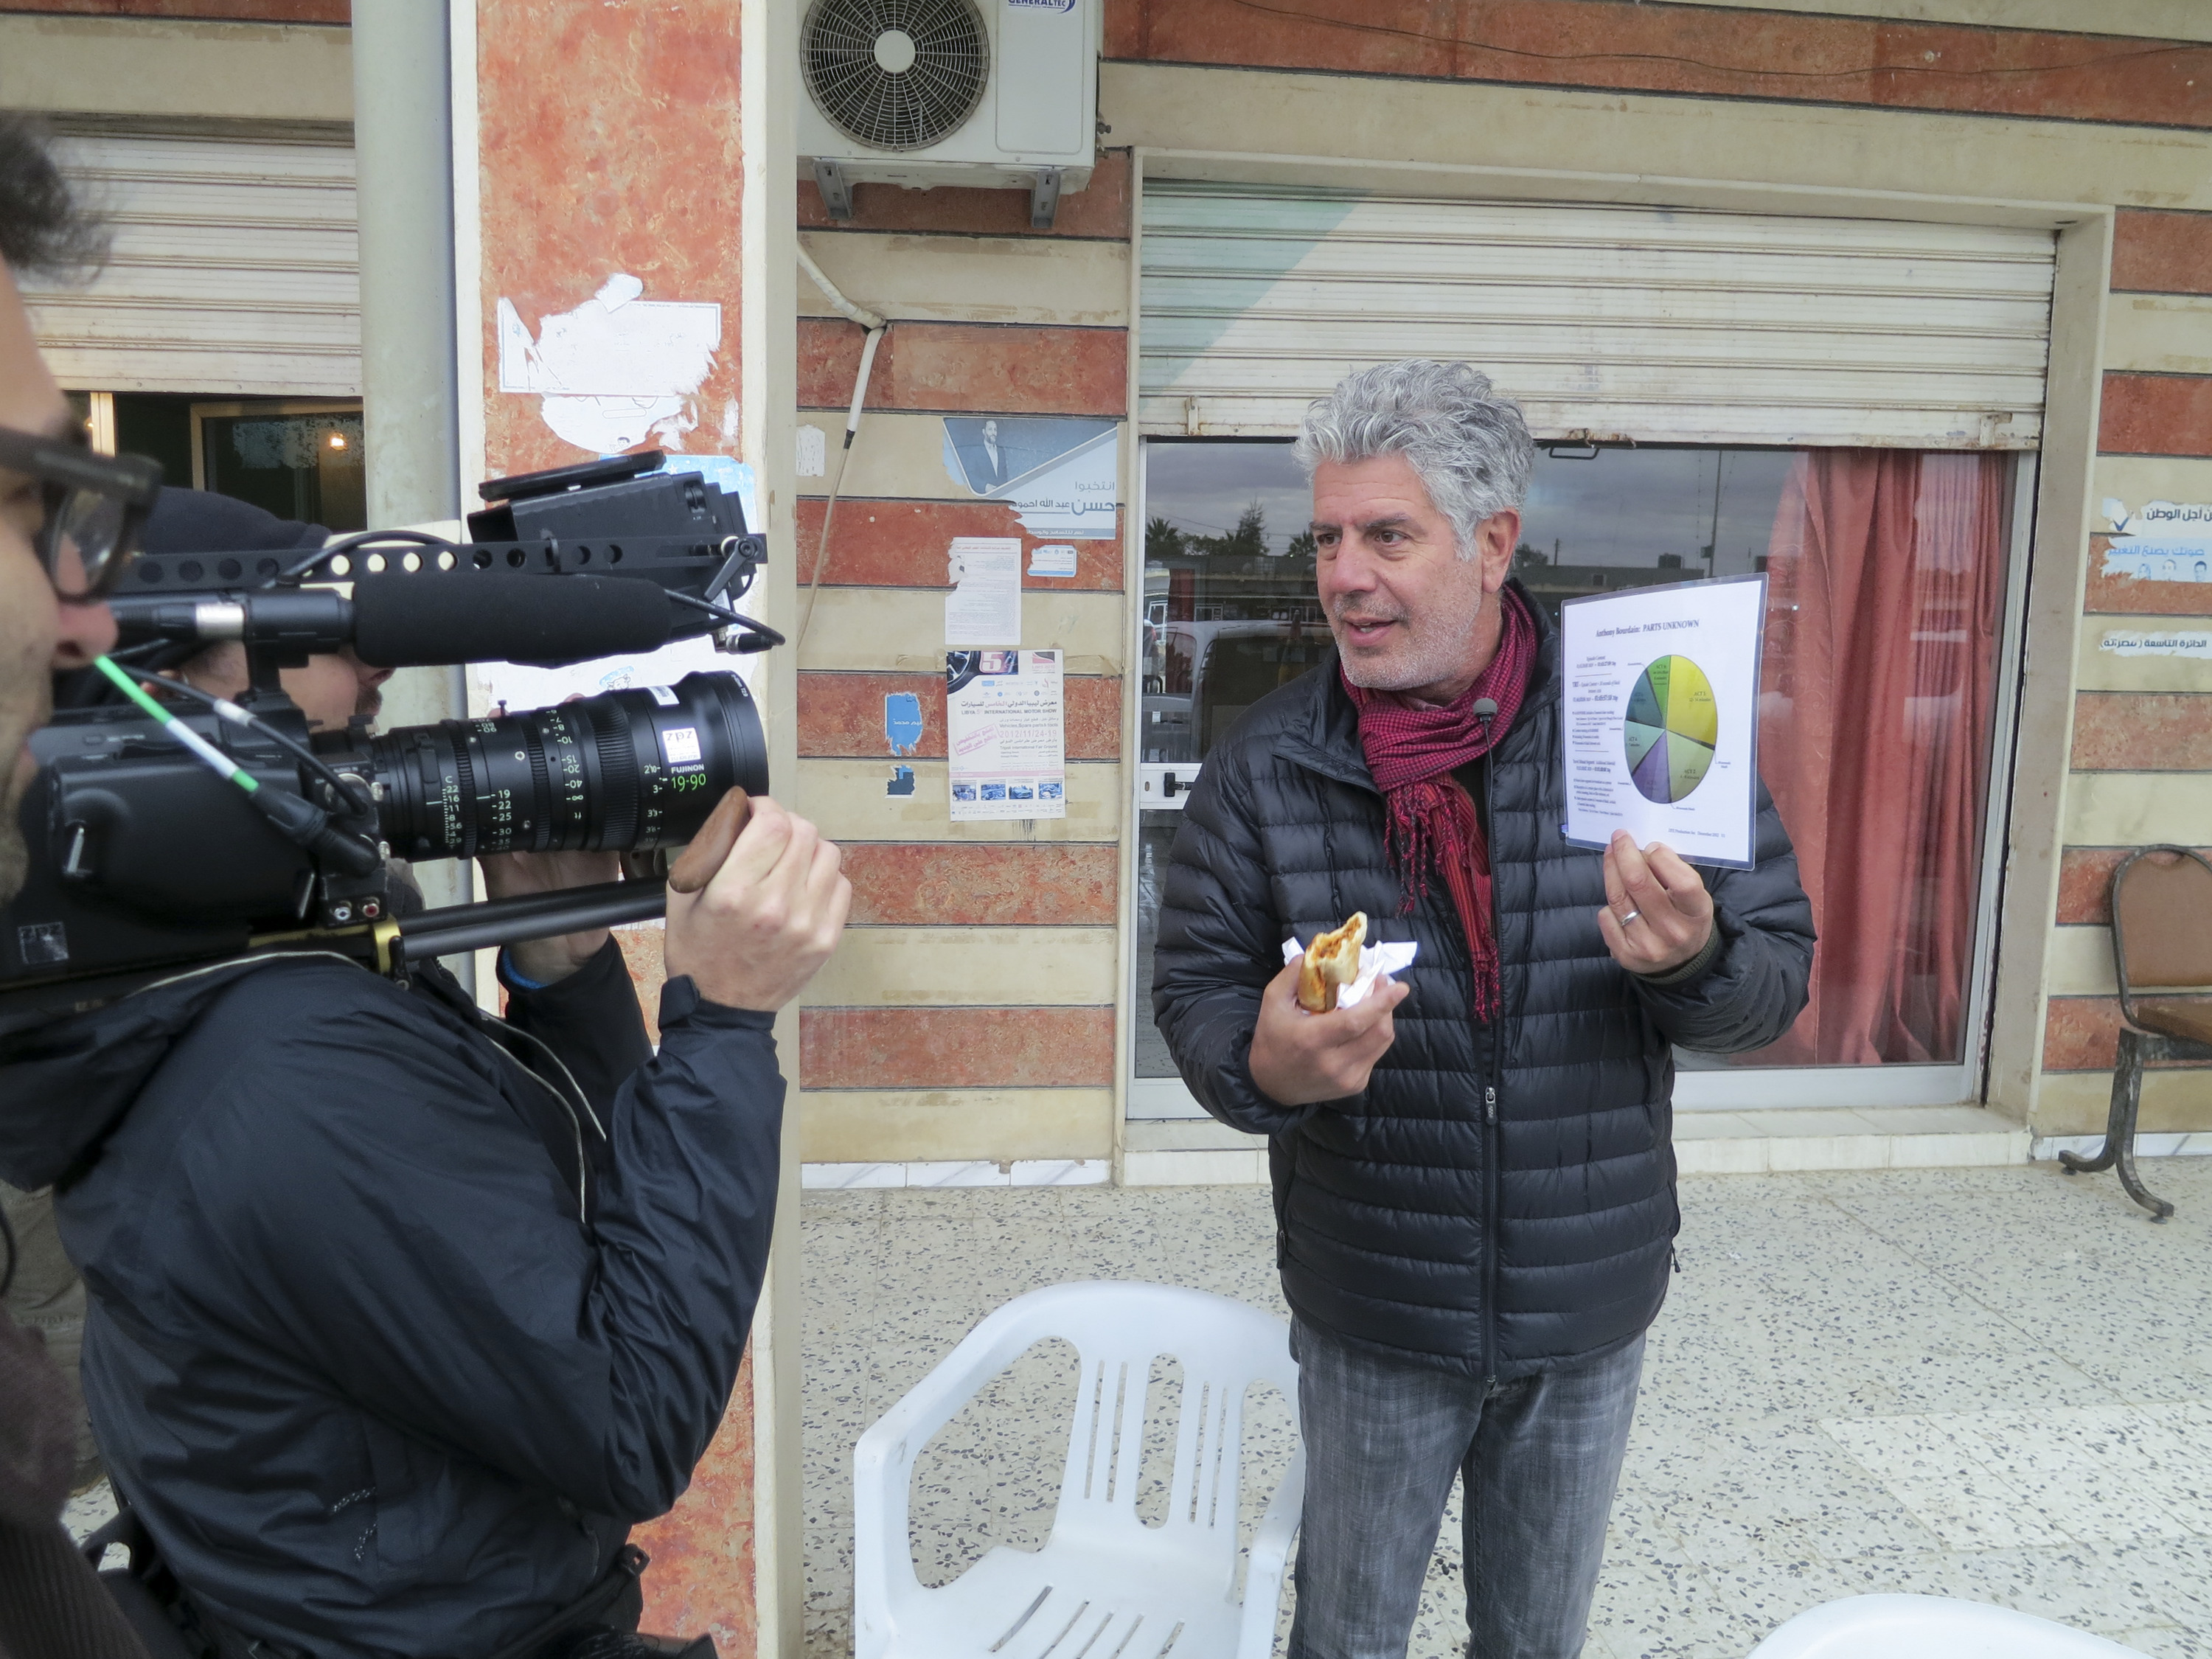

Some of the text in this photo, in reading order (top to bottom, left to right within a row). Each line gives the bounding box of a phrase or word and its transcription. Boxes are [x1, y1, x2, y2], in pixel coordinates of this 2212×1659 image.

[1075, 481, 1115, 493] انتخبوا
[1039, 497, 1054, 508] الله
[1055, 501, 1071, 509] عبد
[1071, 499, 1116, 516] حسن
[2146, 507, 2180, 521] الوطن
[2182, 507, 2202, 521] أجل
[1596, 619, 1700, 637] Anthony Bourdain: PARTS UNKNOWN
[2144, 639, 2177, 648] التاسعة
[2179, 639, 2207, 649] الدائرة
[561, 736, 573, 745] 10
[566, 755, 577, 764] 15
[568, 764, 580, 773] 20
[671, 764, 704, 774] FUJINON
[570, 779, 582, 789] 40
[671, 773, 706, 793] 19-90
[446, 785, 459, 793] 22
[498, 789, 510, 799] 19
[448, 795, 460, 803] 16
[449, 804, 460, 812] 11
[498, 800, 512, 810] 22
[498, 812, 512, 821] 25
